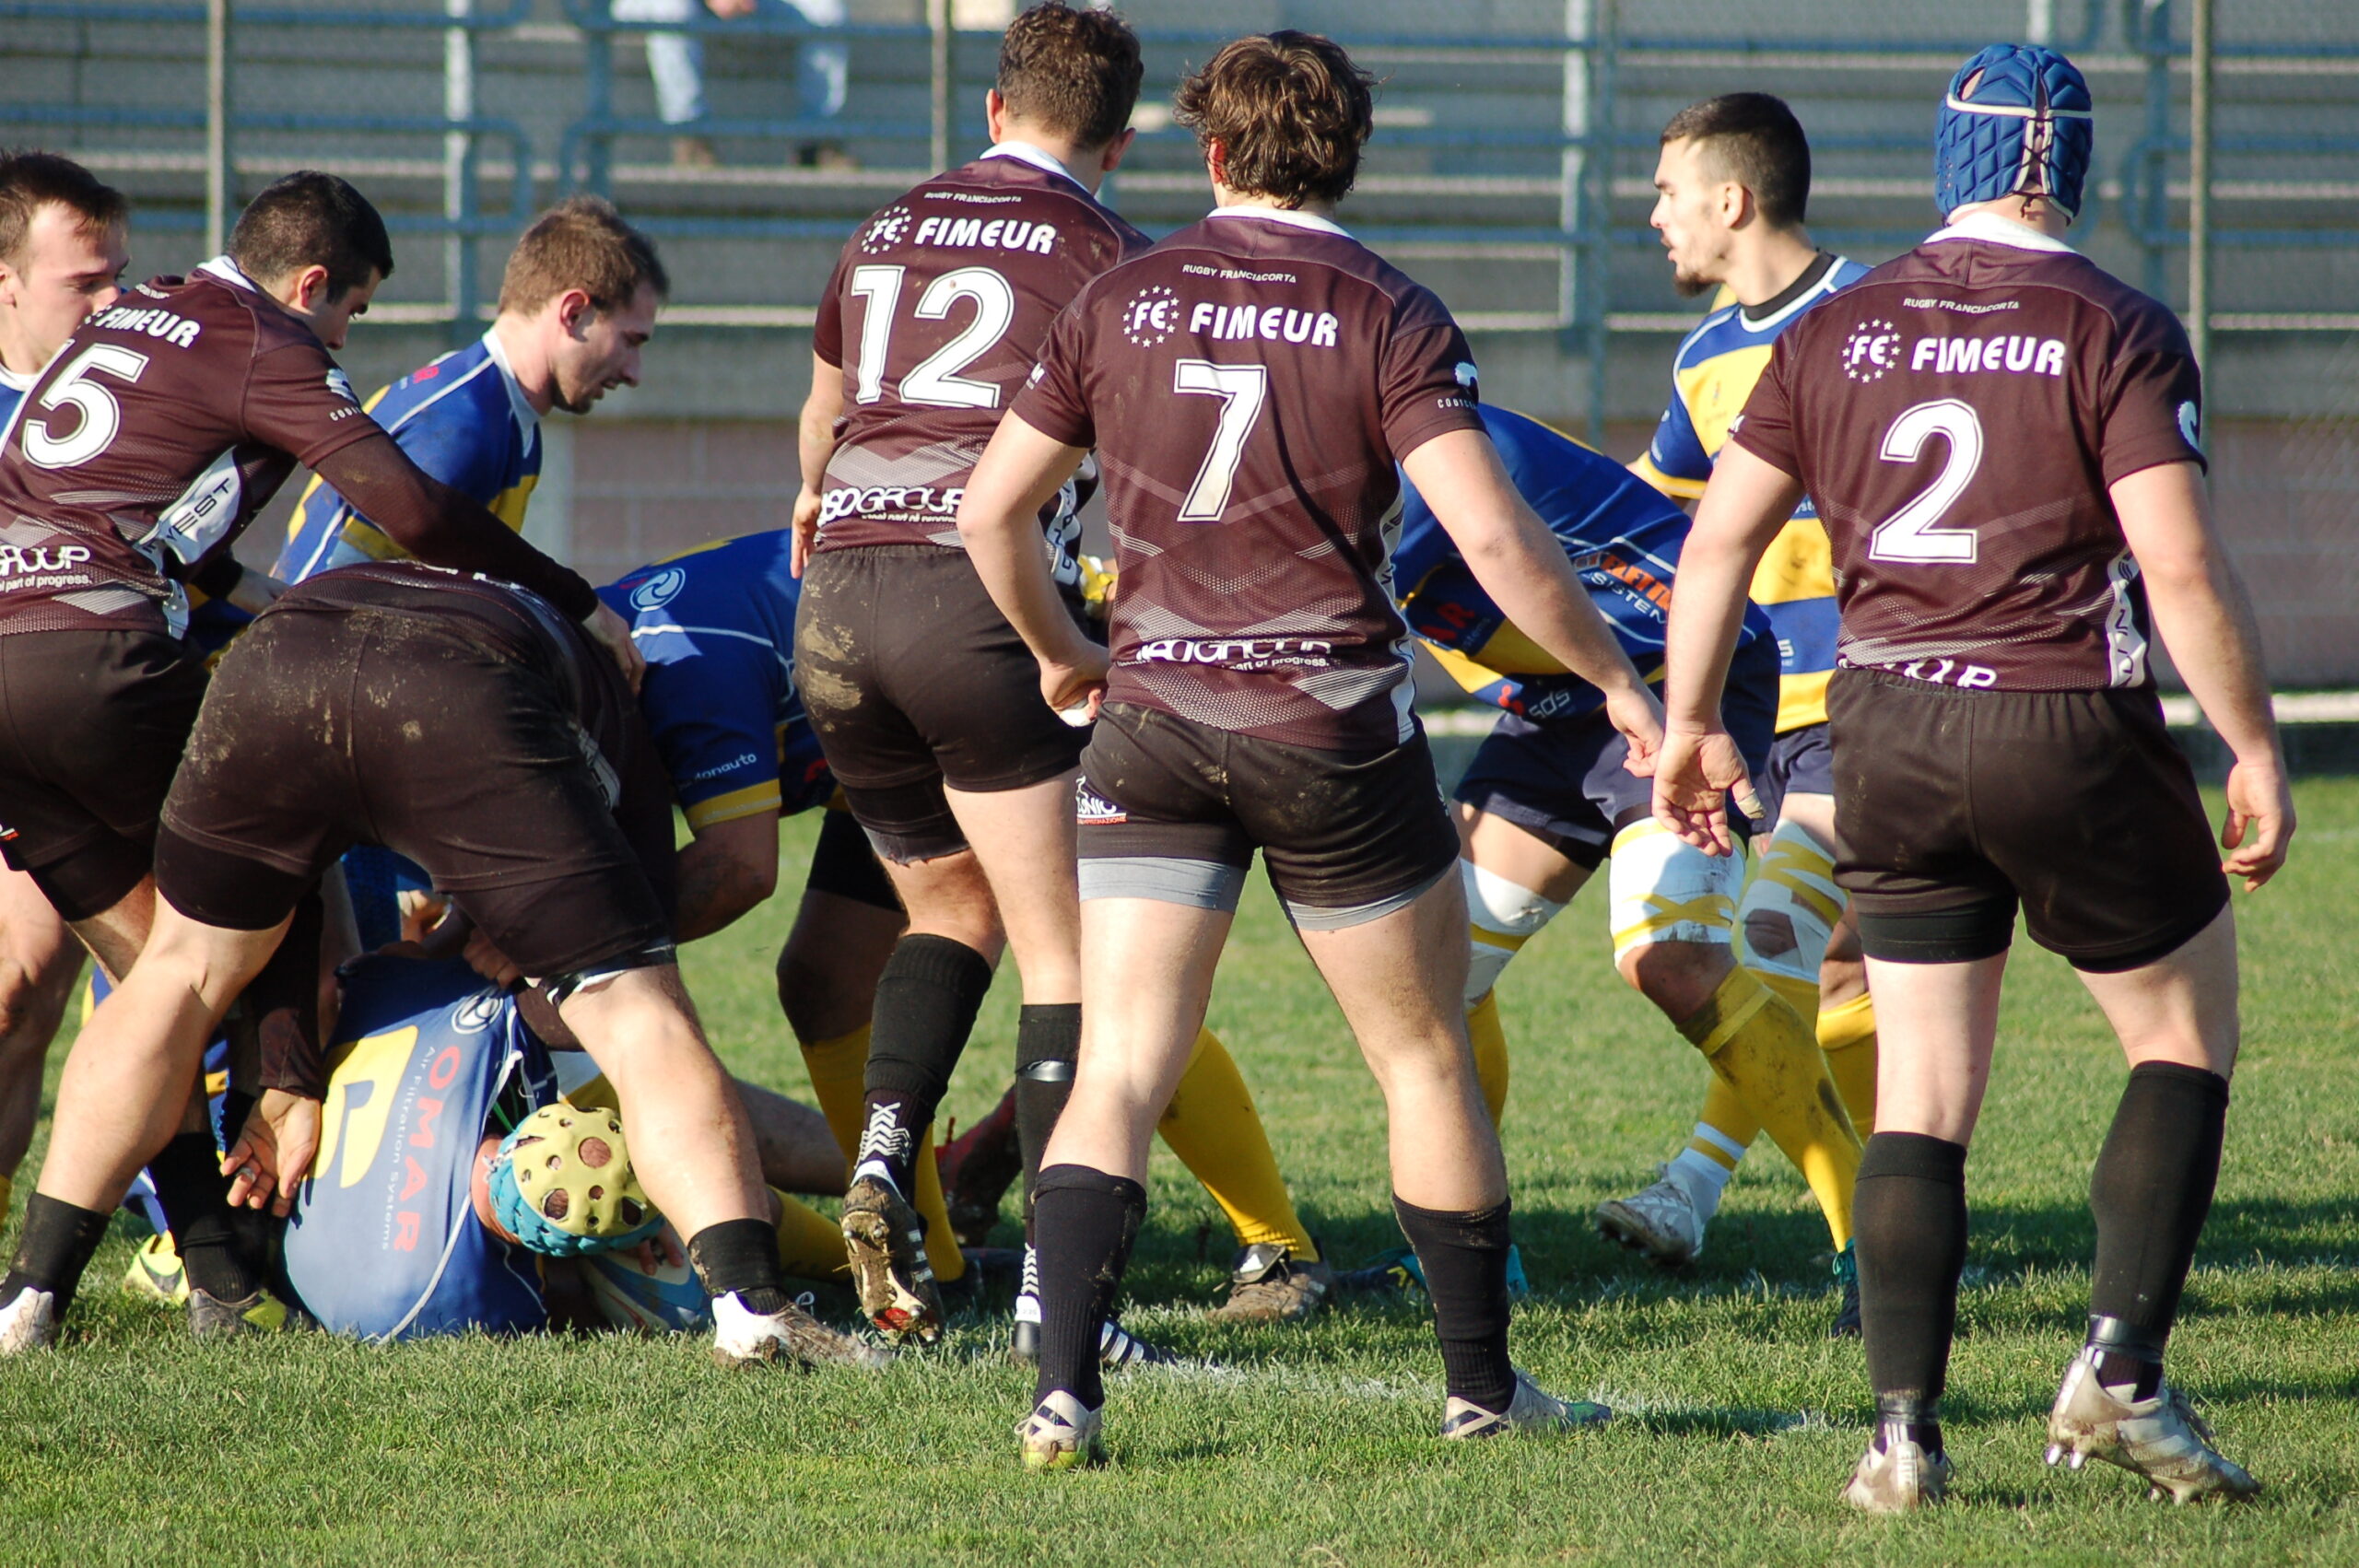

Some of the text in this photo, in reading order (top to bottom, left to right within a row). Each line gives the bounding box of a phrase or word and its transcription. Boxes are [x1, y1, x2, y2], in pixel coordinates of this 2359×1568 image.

[914, 216, 1058, 255] FIMEUR
[1182, 263, 1297, 283] RUGBY FRANCIACORTA
[851, 264, 1015, 409] 12
[1189, 302, 1339, 347] FIMEUR
[1903, 298, 2019, 314] RUGBY FRANCIACORTA
[1910, 335, 2066, 376] FIMEUR
[0, 339, 150, 470] 5
[1173, 358, 1267, 522] 7
[1869, 398, 1984, 564] 2
[393, 1045, 462, 1252] OMAR
[381, 1171, 399, 1250] Systems
